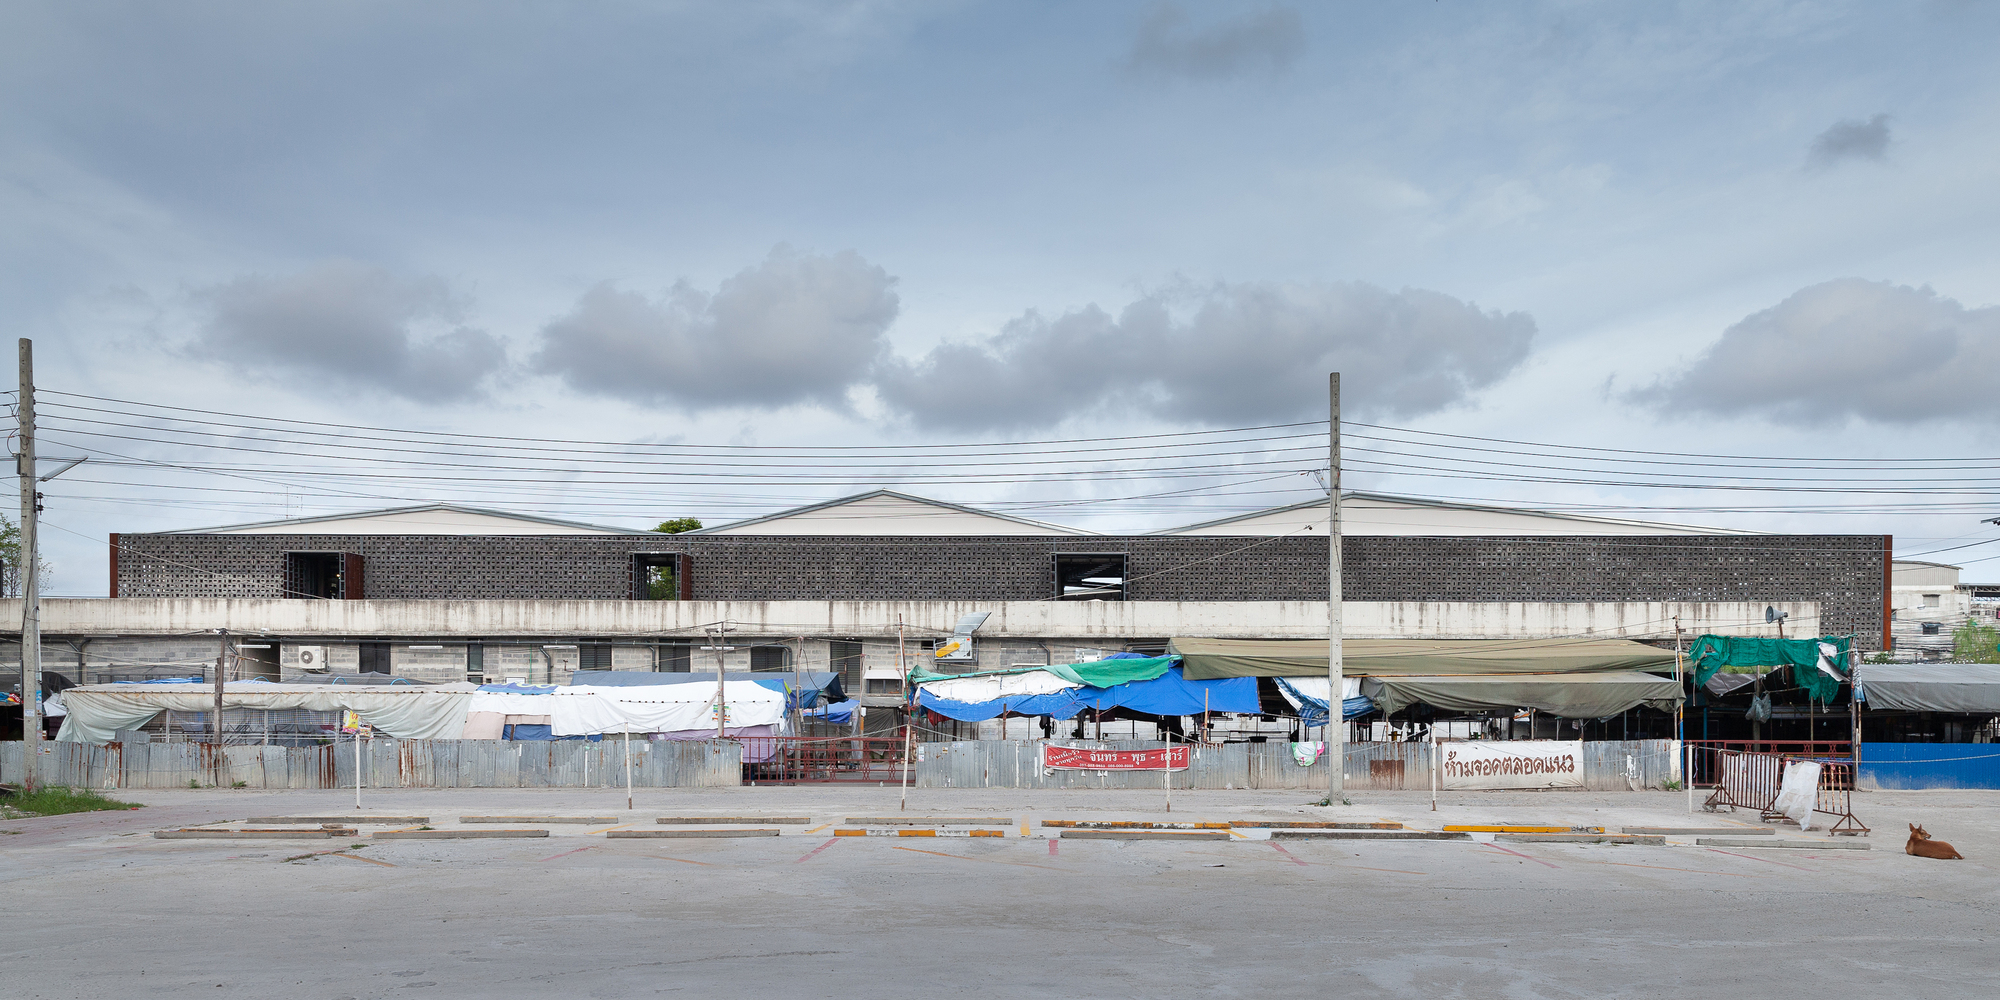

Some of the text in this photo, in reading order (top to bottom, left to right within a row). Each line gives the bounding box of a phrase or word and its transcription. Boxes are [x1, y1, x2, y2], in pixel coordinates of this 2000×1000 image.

[1131, 753, 1146, 765] พุธ
[1444, 750, 1575, 777] ห้ามจอดตลอดแนว
